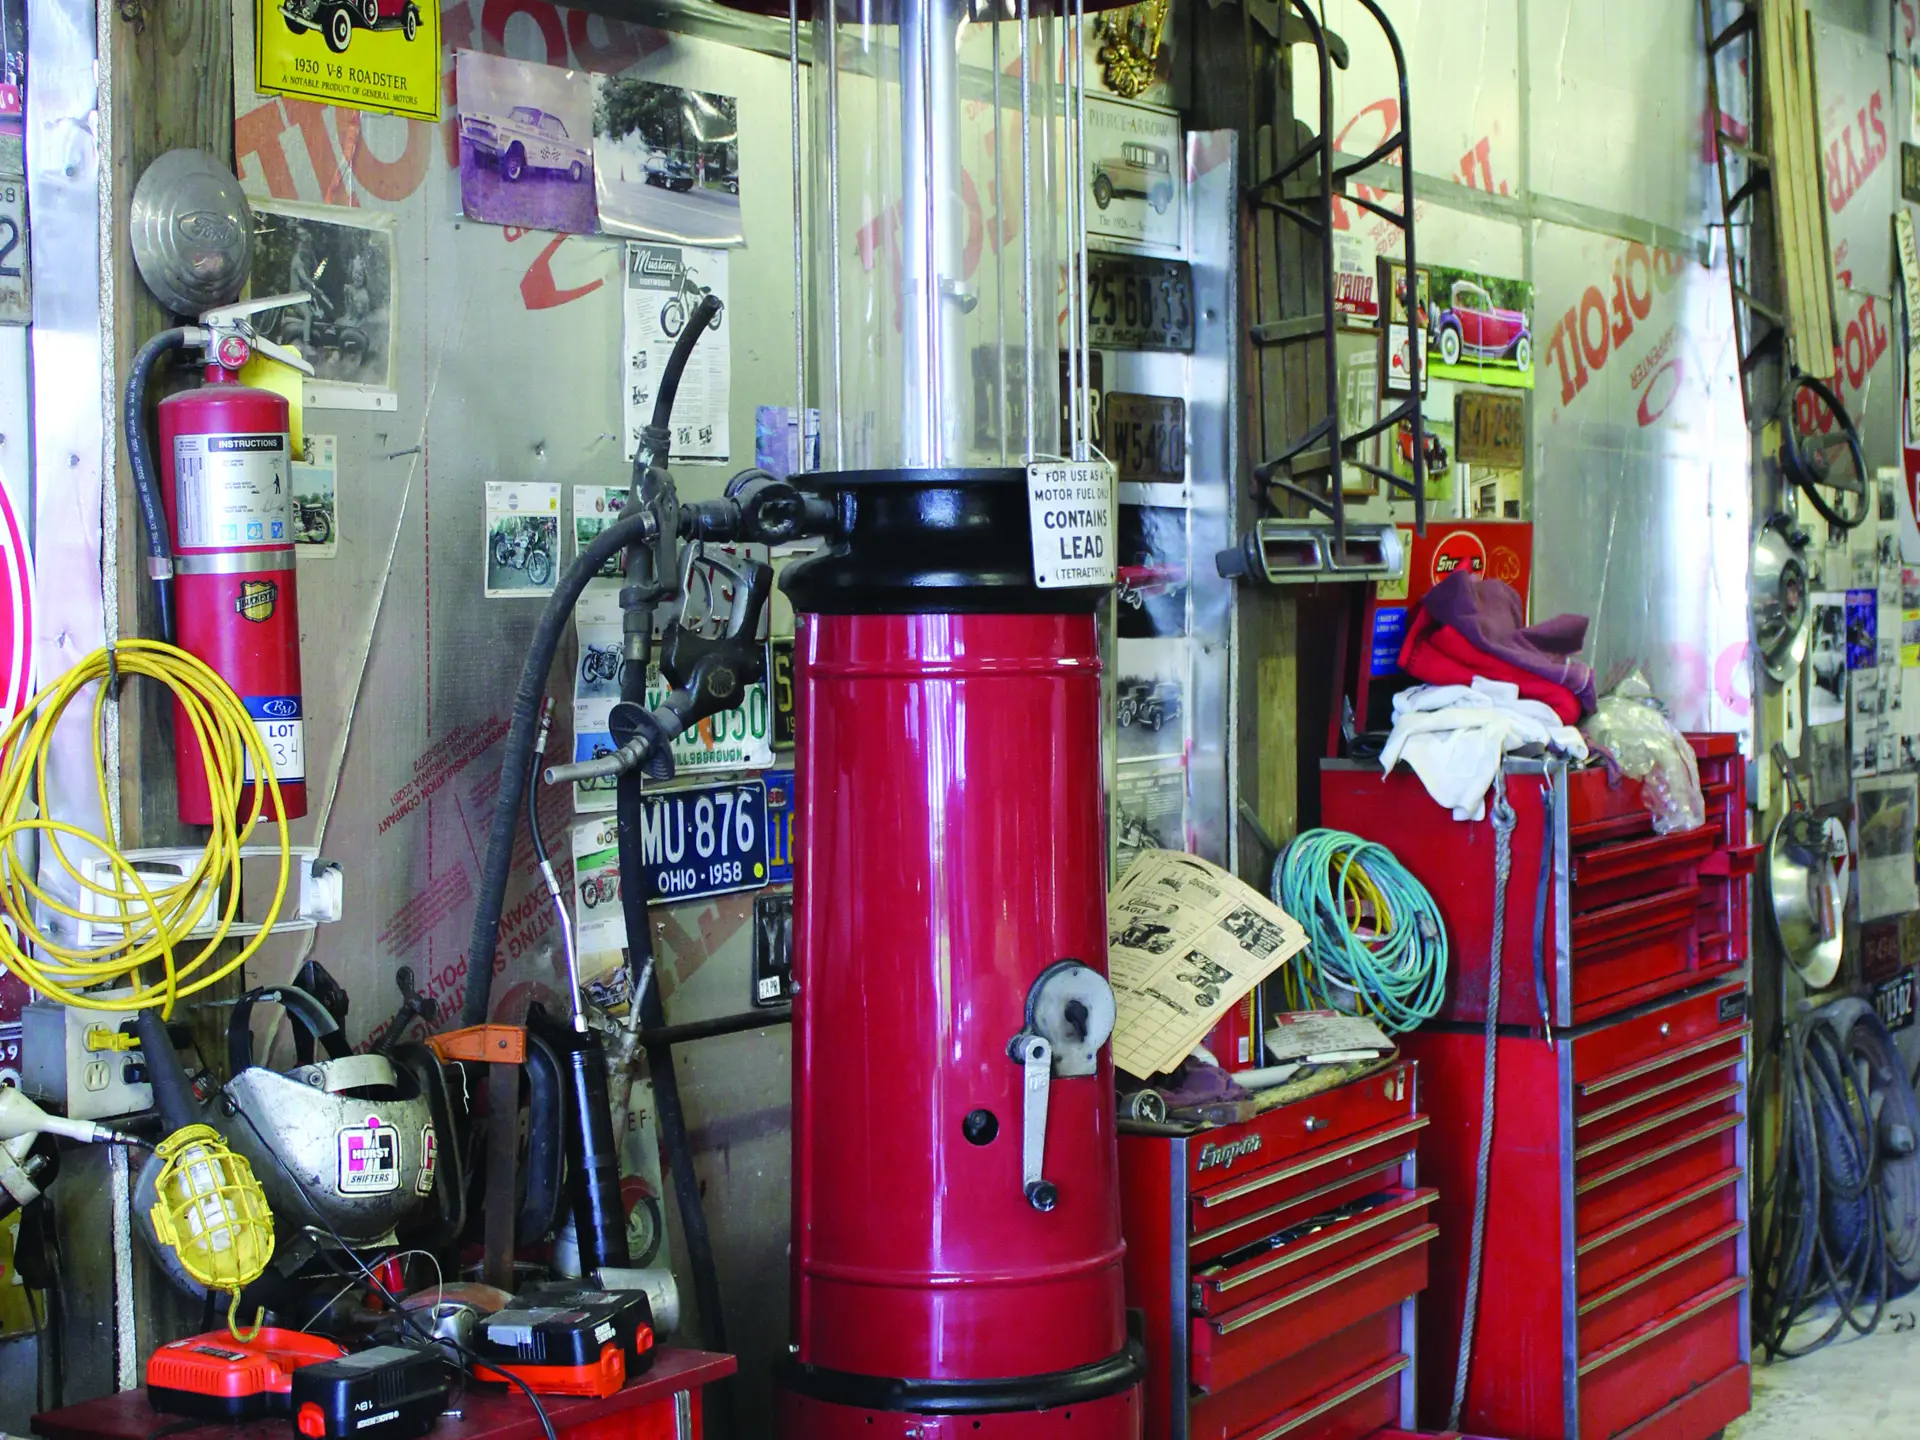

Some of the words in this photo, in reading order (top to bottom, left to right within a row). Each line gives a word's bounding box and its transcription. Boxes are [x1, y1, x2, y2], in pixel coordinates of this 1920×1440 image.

[294, 58, 319, 74] 1930
[327, 63, 343, 79] V-8
[349, 67, 407, 90] ROADSTER
[281, 75, 288, 83] A
[290, 76, 319, 89] NOTABLE
[321, 82, 350, 94] PRODUCT
[352, 86, 359, 95] OF
[361, 88, 390, 100] GENERAL
[393, 94, 418, 105] MOTORS
[1089, 108, 1169, 137] PIERCE-ARROW
[632, 249, 679, 280] Mustang
[219, 439, 277, 449] INSTRUCTIONS
[1046, 470, 1066, 483] FOR
[1071, 470, 1088, 482] USE
[1090, 470, 1098, 481] AS
[1035, 489, 1072, 501] MOTOR
[1077, 488, 1095, 500] FUEL
[1044, 509, 1107, 529] CONTAINS
[1060, 535, 1104, 560] LEAD
[269, 724, 295, 738] LOT
[467, 718, 513, 760] ARPENTER
[674, 748, 743, 766] ILLSBOROUGH
[376, 794, 420, 835] COMPANY
[658, 868, 697, 893] OHIO
[709, 861, 742, 885] 1958
[1117, 904, 1148, 915] EAGLE
[352, 1148, 390, 1160] HURST
[351, 1173, 390, 1184] SHIFTERS
